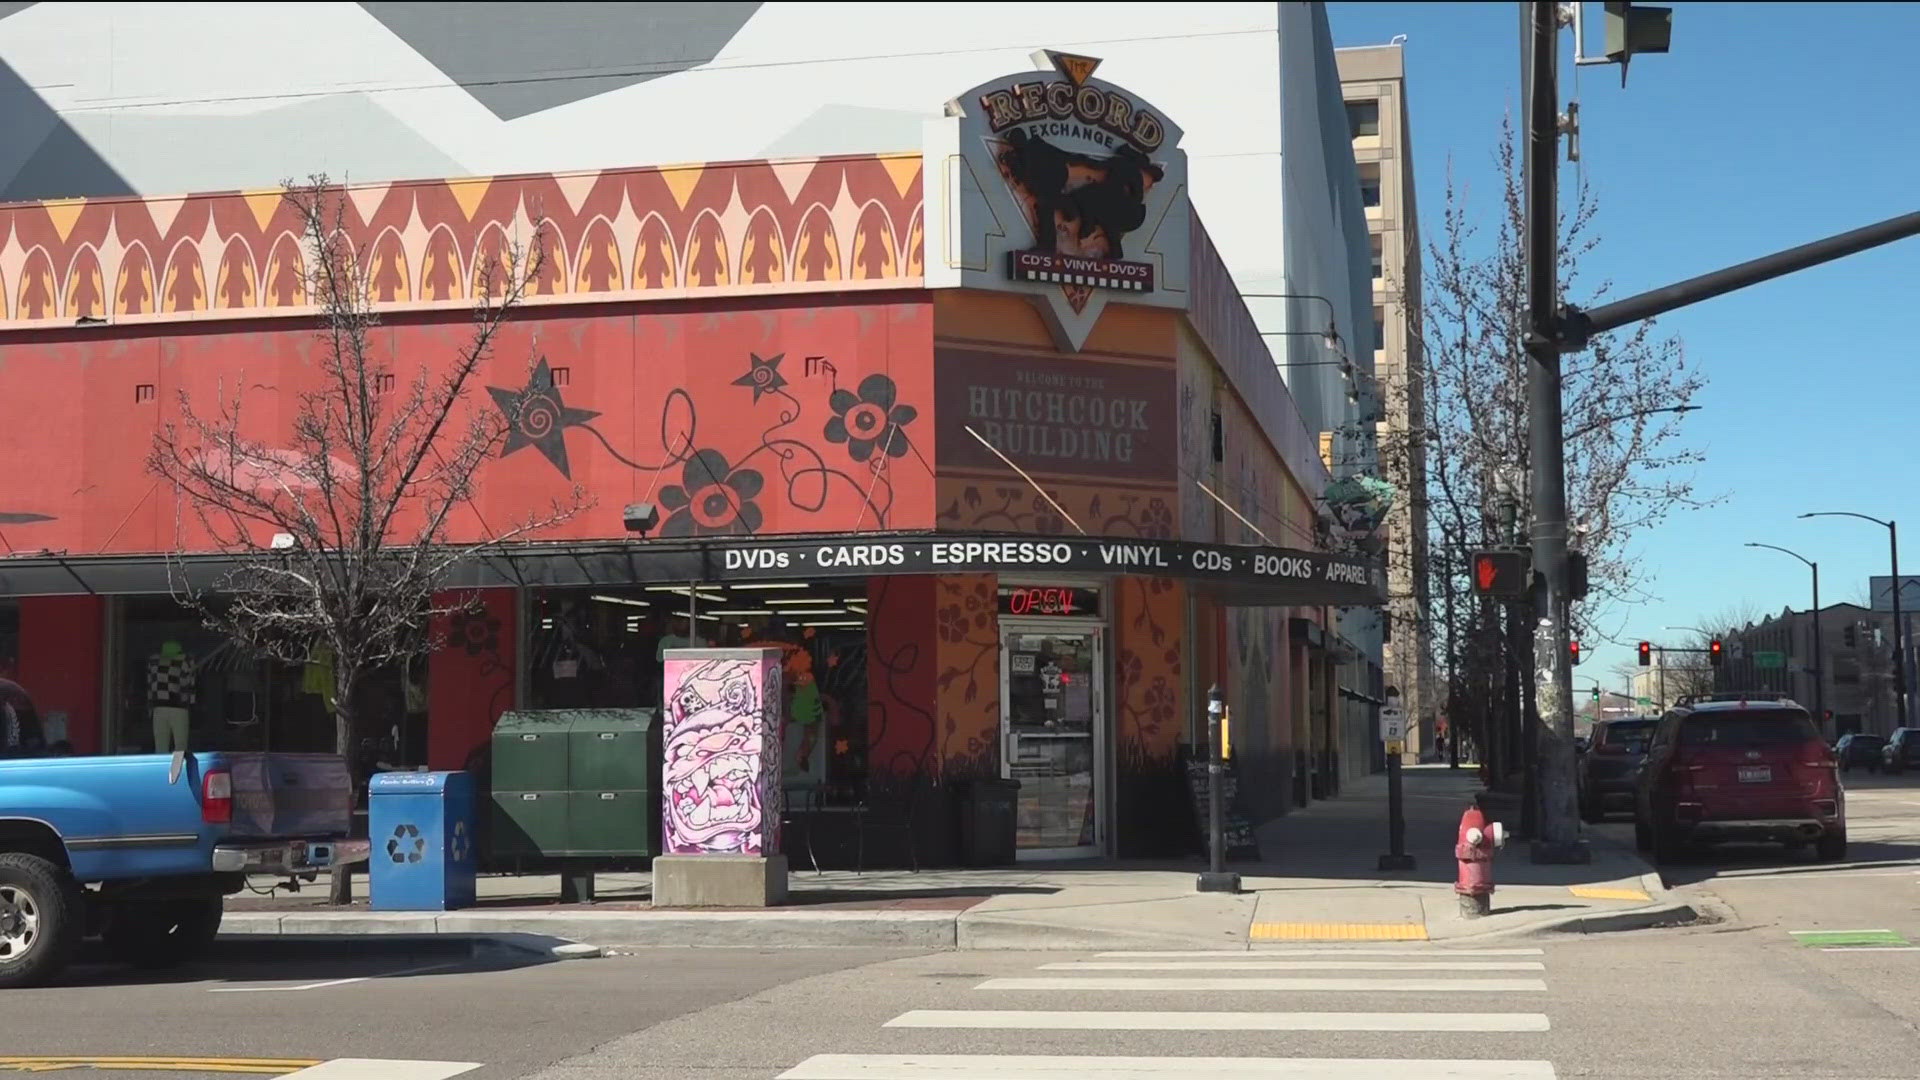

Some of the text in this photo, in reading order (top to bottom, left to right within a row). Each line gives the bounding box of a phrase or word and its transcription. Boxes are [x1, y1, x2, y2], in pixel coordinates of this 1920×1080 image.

[980, 81, 1164, 153] RECORD
[1029, 122, 1115, 149] EXCHANGE
[1021, 254, 1148, 277] CD'S VINYL DVD'S
[968, 385, 1149, 430] HITCHCOCK
[984, 420, 1134, 462] BUILDING
[725, 549, 790, 569] DVDs
[816, 545, 905, 567] CARDS
[931, 543, 1072, 565] ESPRESSO
[1100, 544, 1168, 567] VINYL
[1192, 550, 1233, 571] CDs
[1254, 554, 1312, 579] BOOKS
[1325, 562, 1367, 585] APPAREL
[1011, 588, 1073, 615] OPEN
